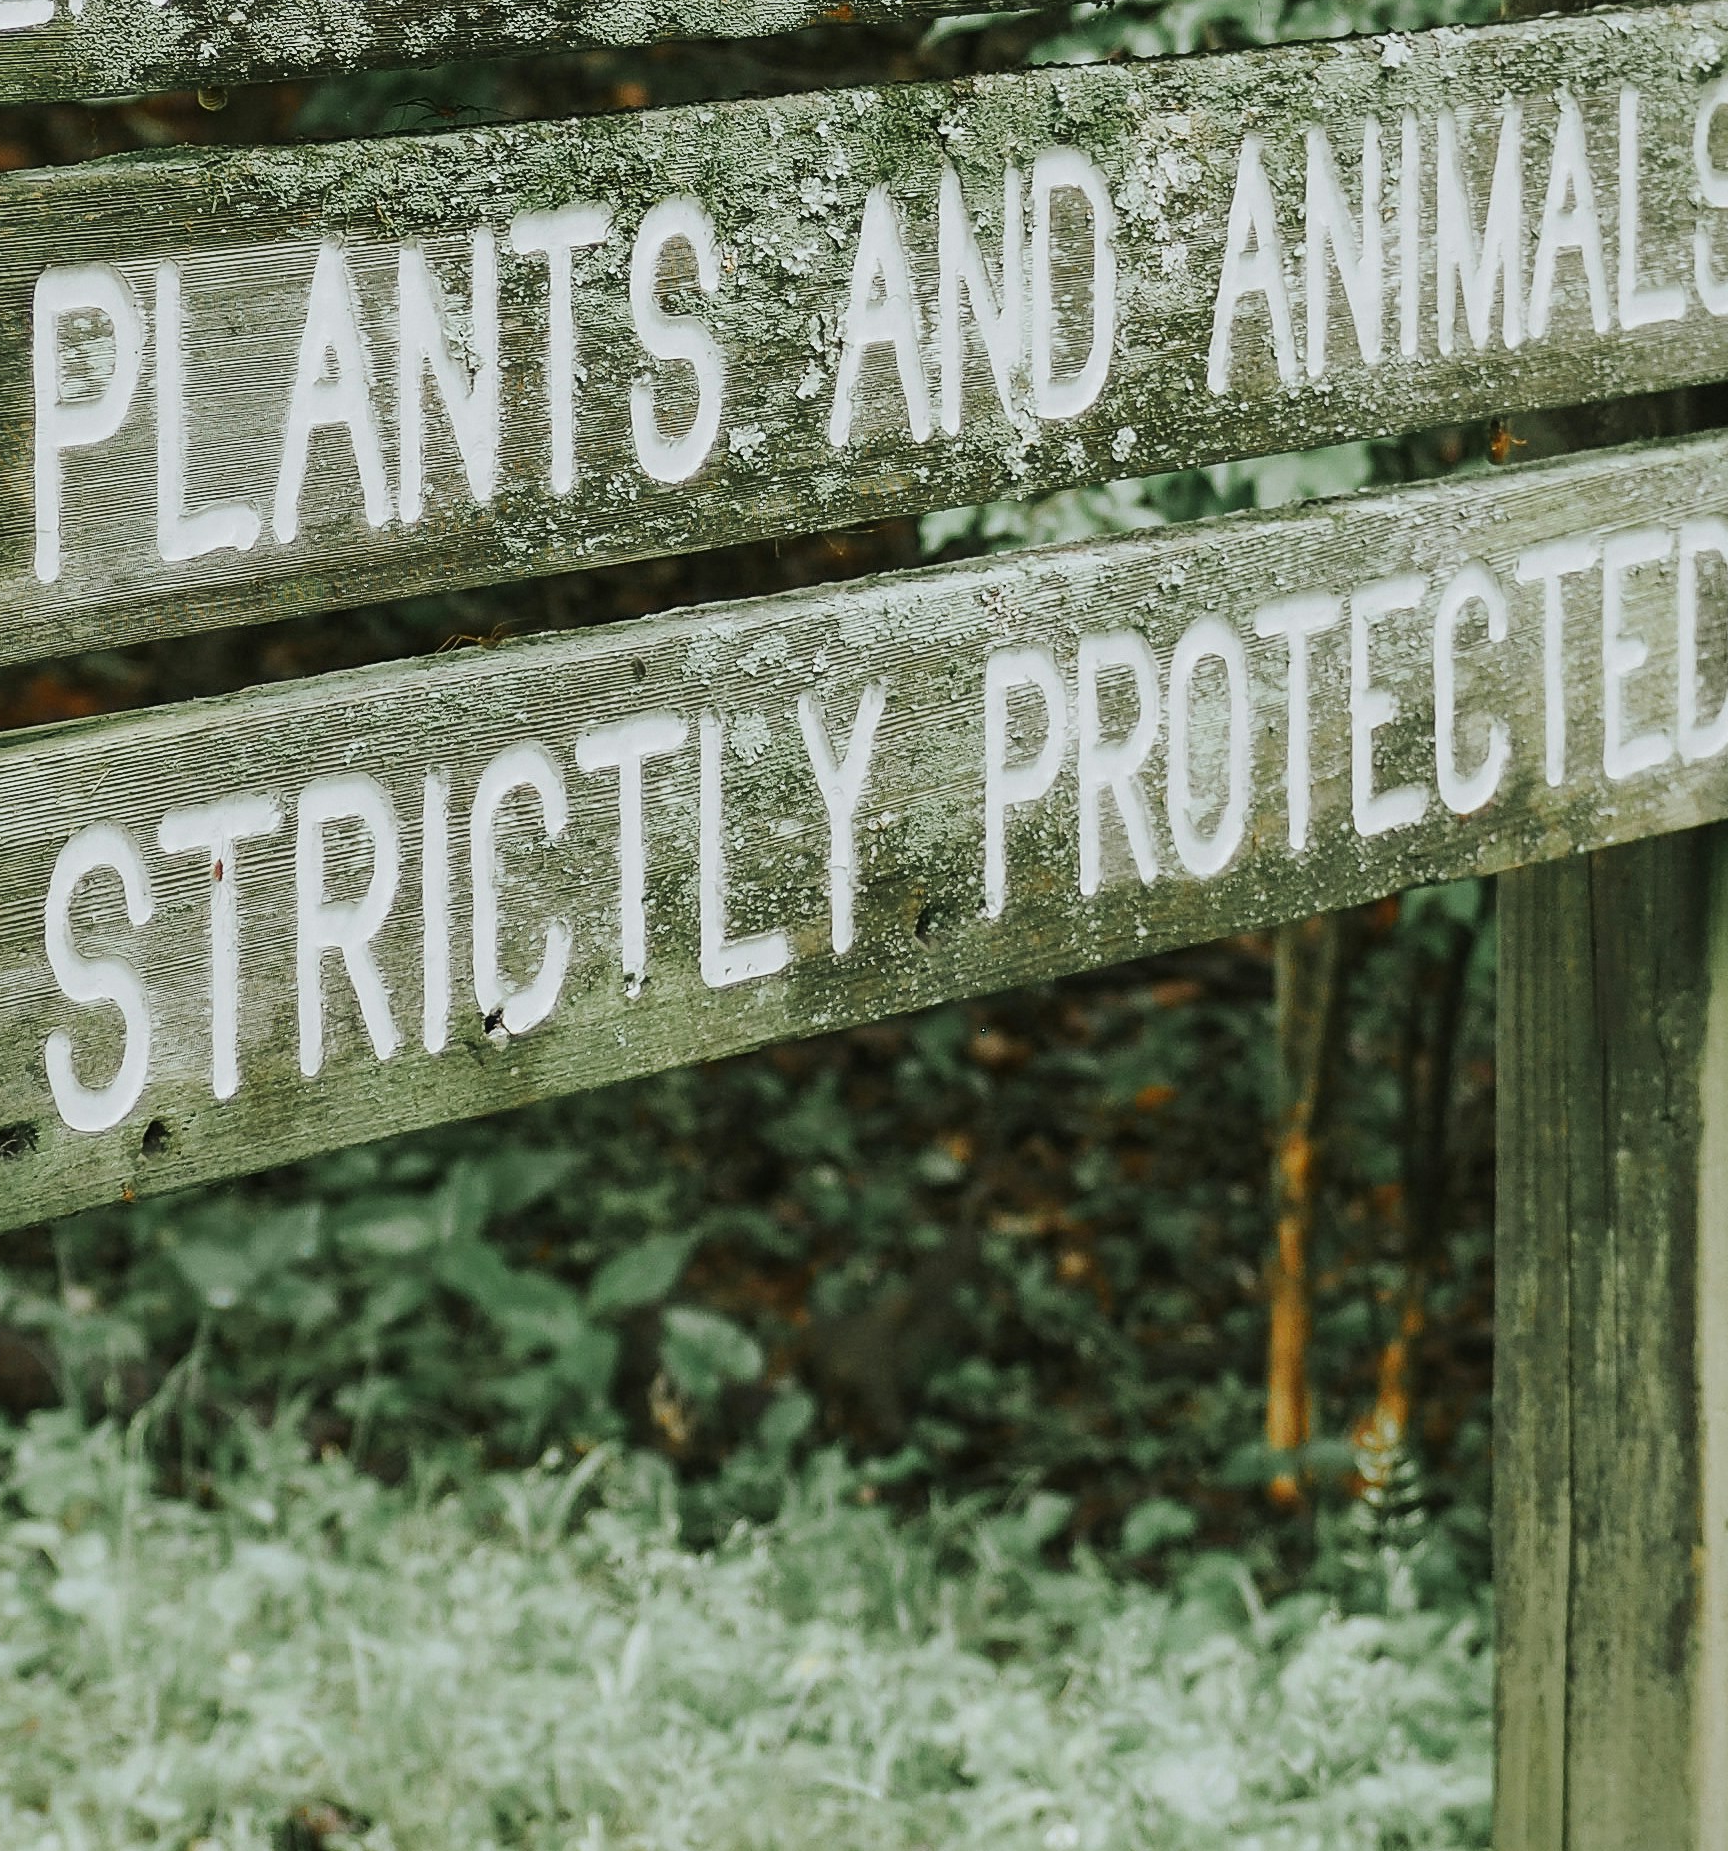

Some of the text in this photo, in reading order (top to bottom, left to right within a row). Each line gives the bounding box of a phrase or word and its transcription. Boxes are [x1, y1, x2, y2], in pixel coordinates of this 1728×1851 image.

[33, 194, 723, 584] PLANTS
[828, 147, 1117, 447] AND
[44, 679, 887, 1133] STRICTLY
